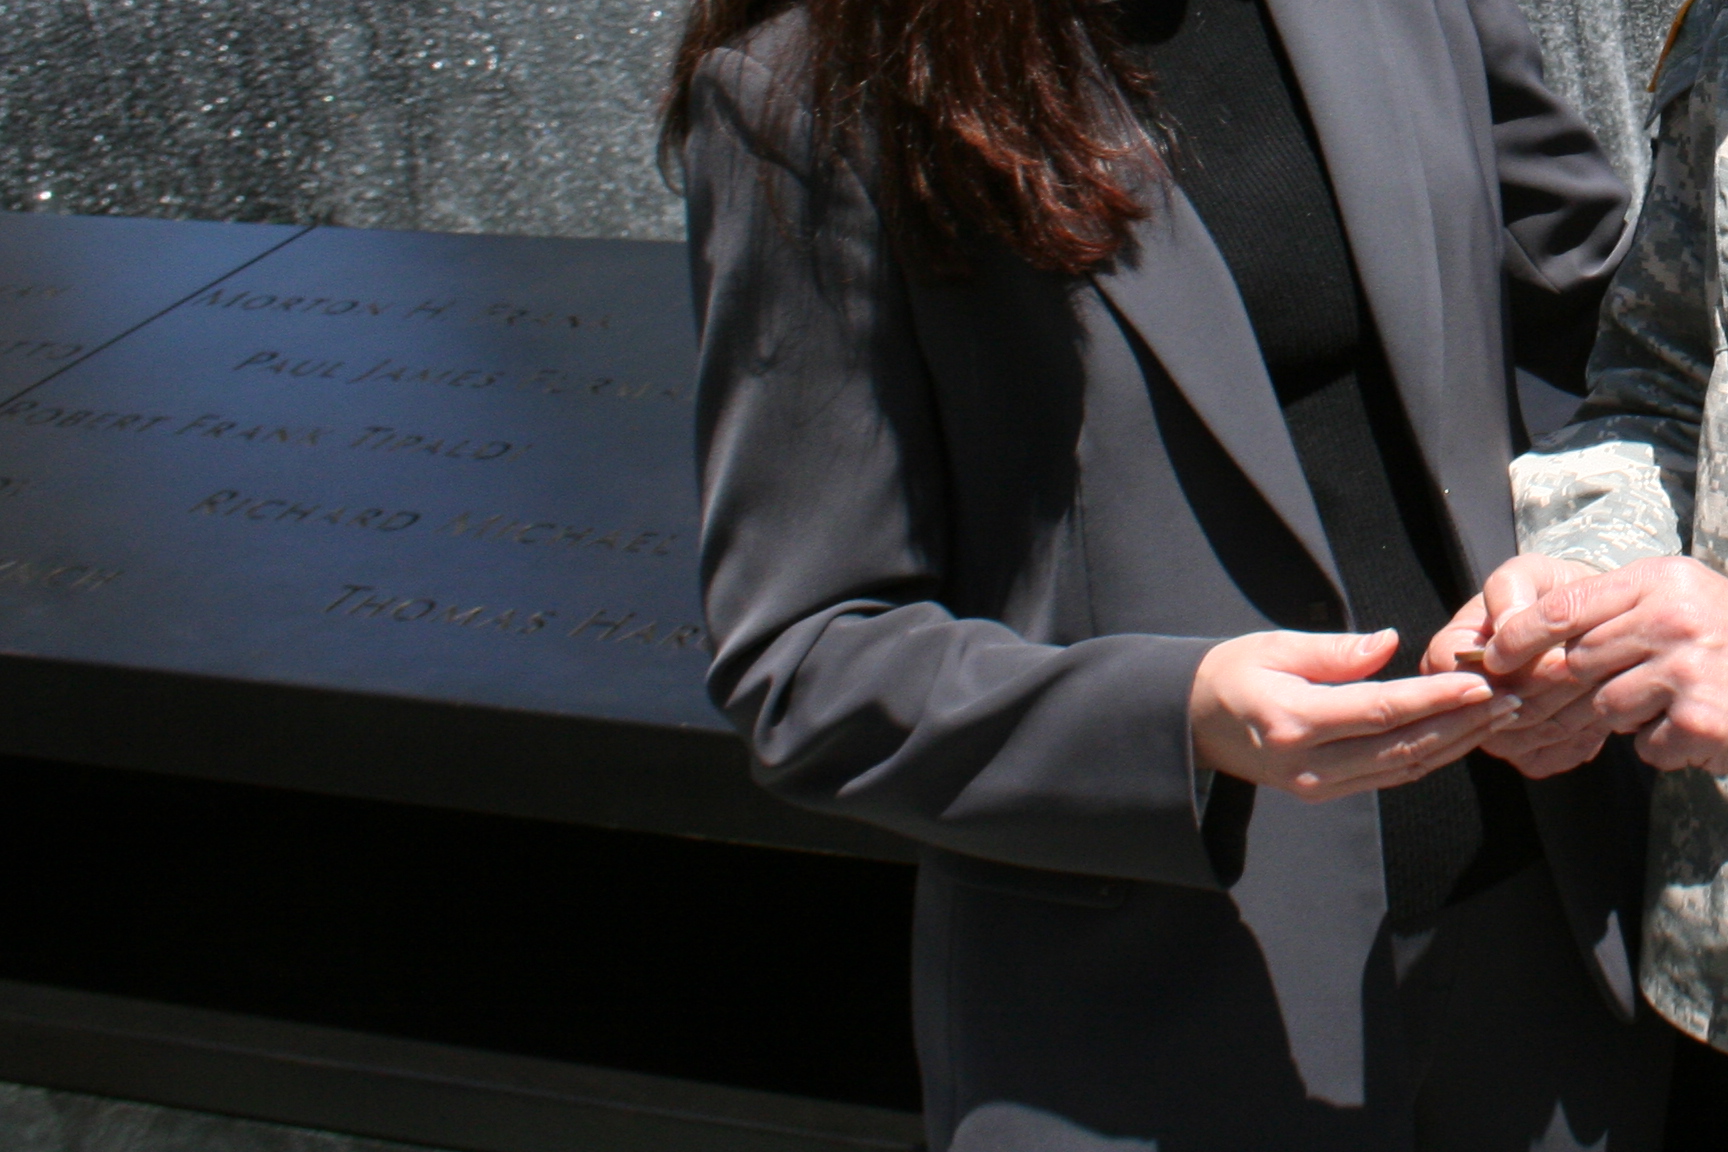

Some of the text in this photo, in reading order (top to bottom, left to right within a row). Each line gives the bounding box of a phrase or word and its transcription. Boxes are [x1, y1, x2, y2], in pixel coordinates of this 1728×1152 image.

[193, 288, 396, 316] MORTON
[233, 350, 345, 379] PAUL
[346, 357, 505, 389] JAMES
[0, 399, 173, 432] ROBERT
[174, 412, 335, 447] FRANK
[188, 487, 681, 558] RICHARD MICHAEL
[322, 583, 710, 652] THOMAS HAR
